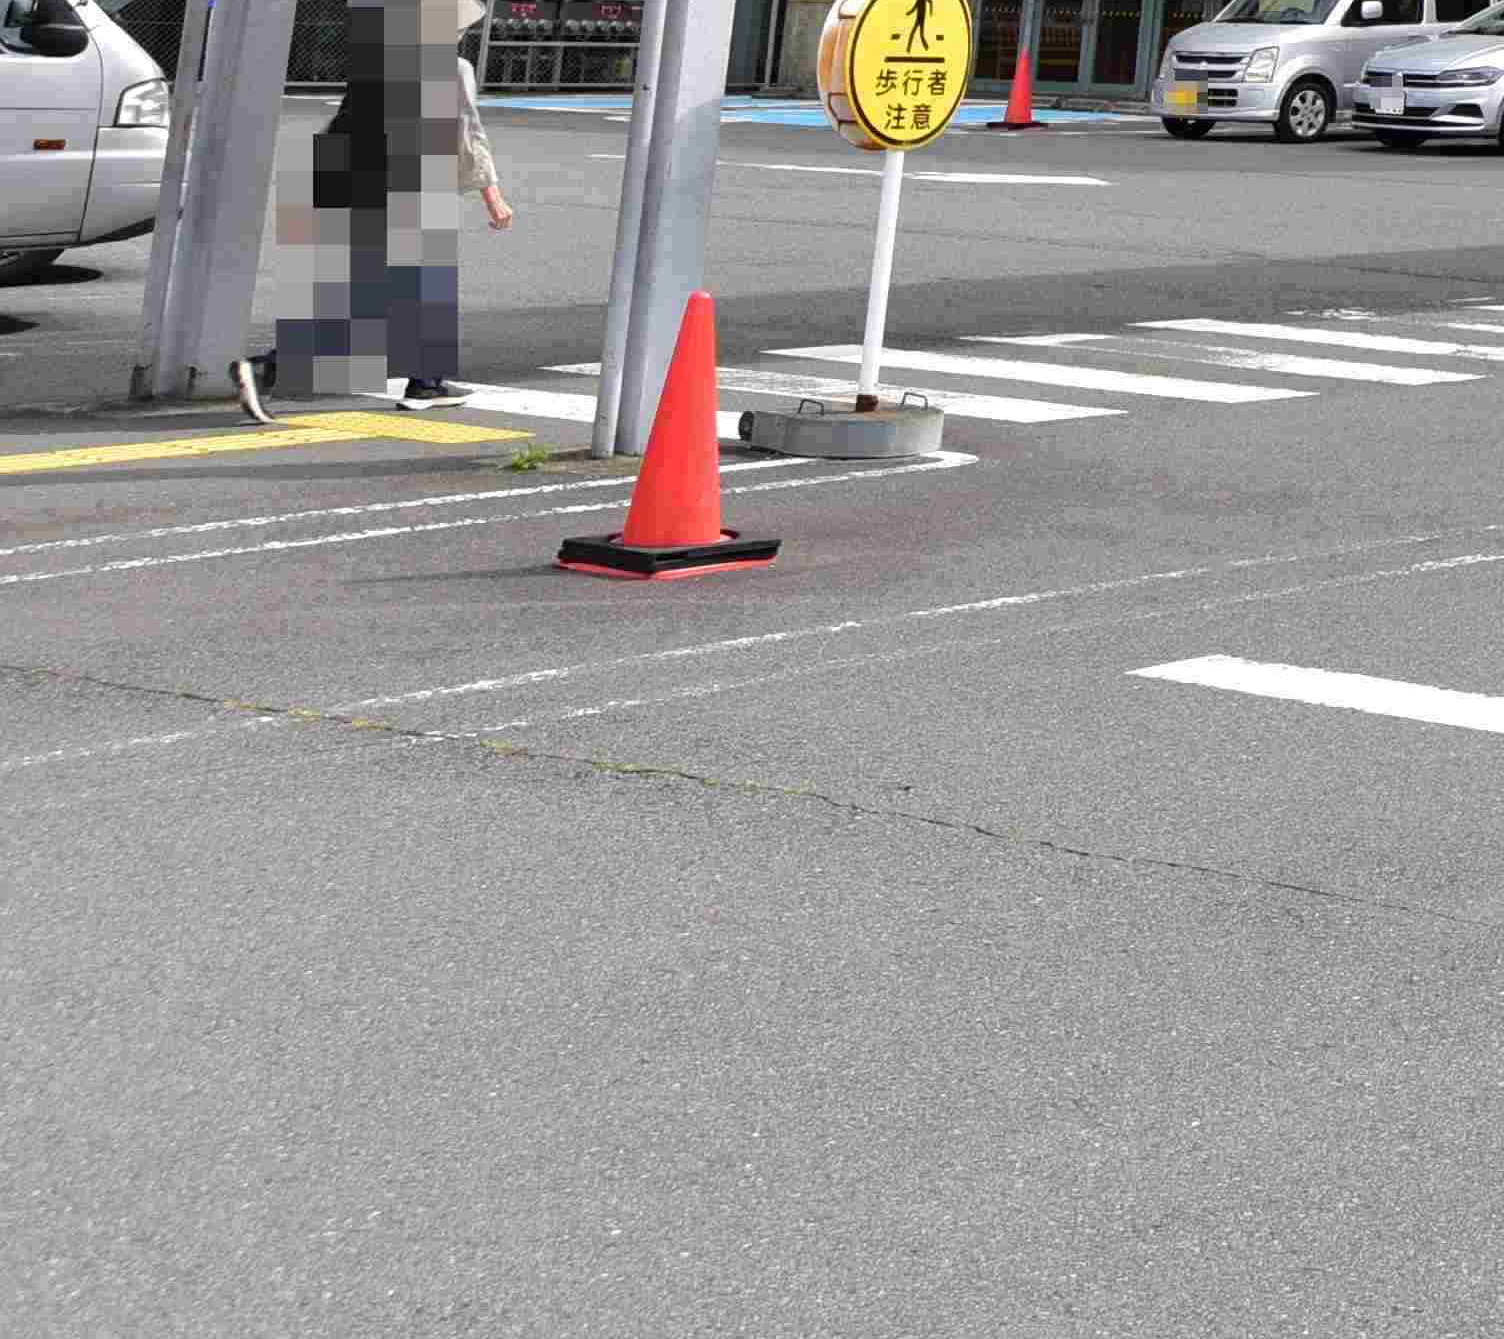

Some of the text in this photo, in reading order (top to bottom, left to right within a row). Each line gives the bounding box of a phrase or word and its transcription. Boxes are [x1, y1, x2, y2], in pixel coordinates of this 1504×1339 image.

[875, 69, 947, 97] 歩行者
[884, 103, 933, 130] 注意
